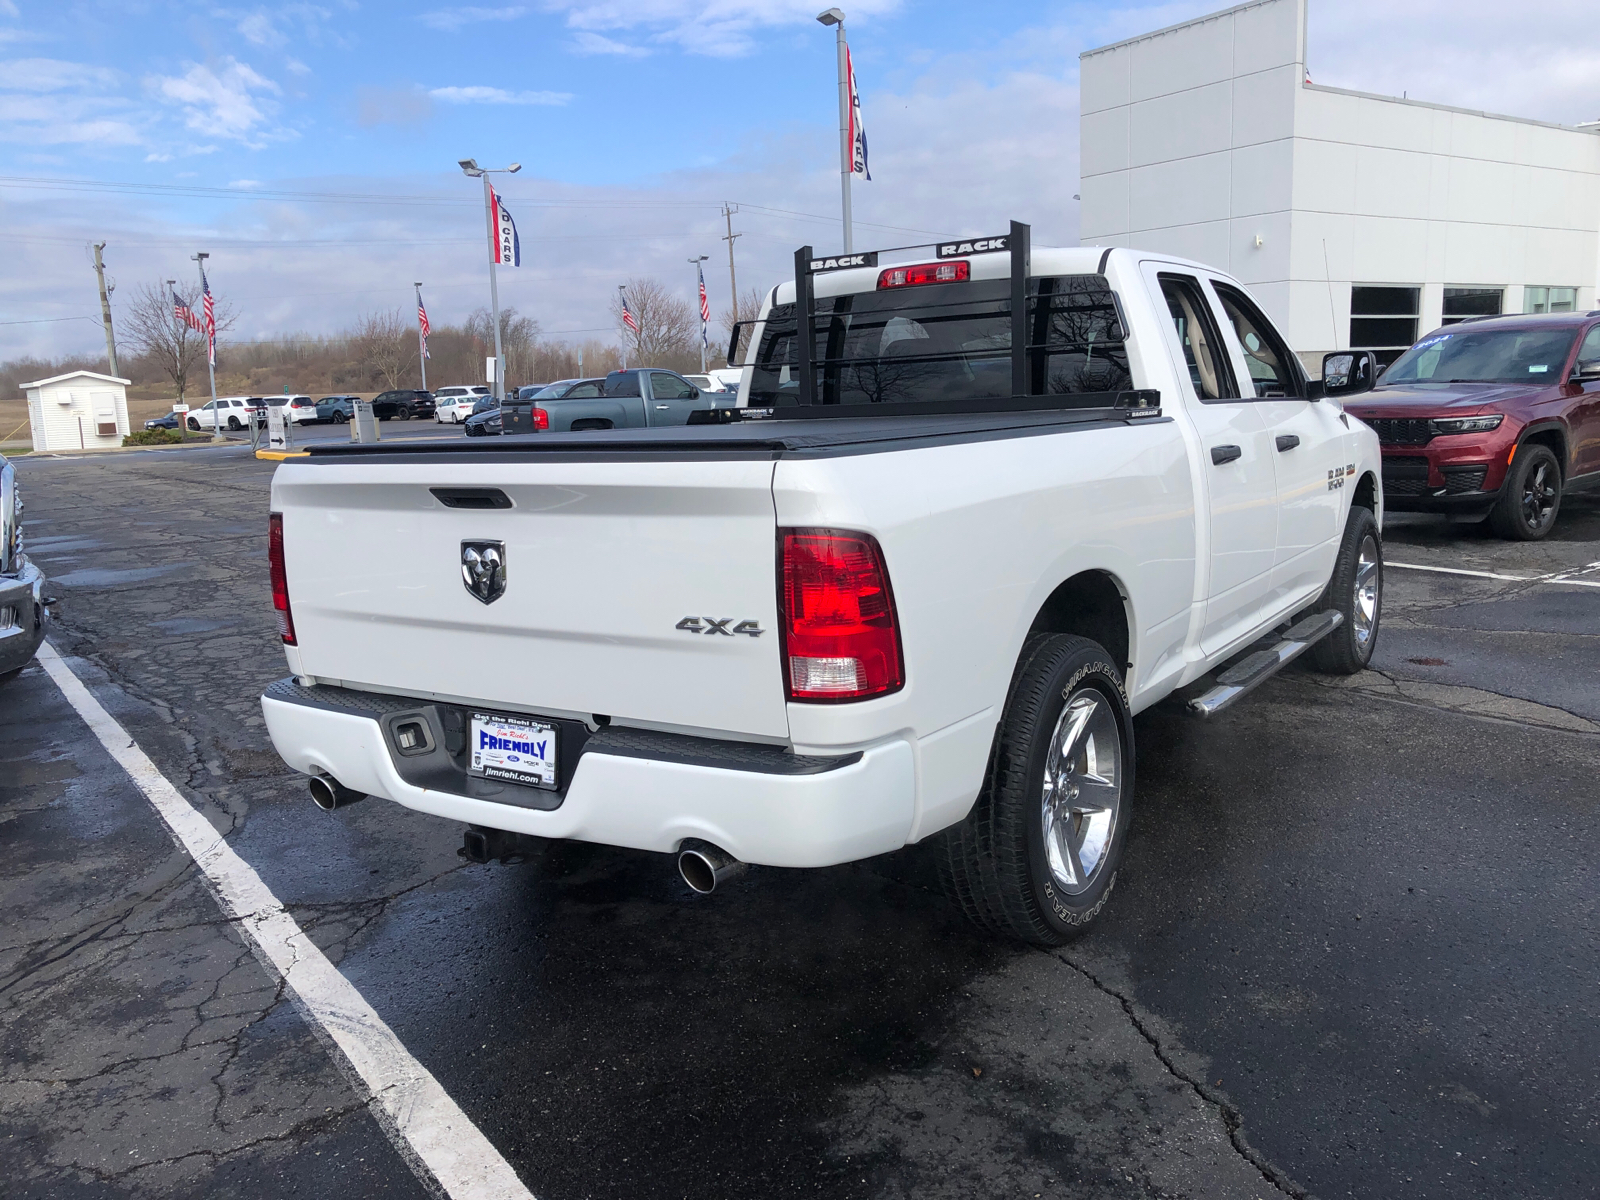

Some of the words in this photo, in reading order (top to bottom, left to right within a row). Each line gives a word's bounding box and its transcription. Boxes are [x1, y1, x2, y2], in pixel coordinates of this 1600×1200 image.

[502, 228, 511, 262] CARS
[810, 255, 865, 270] BACK
[941, 238, 1005, 256] RACK
[1131, 410, 1158, 418] BACKRACK
[675, 616, 766, 638] 4X4
[474, 713, 490, 721] Get
[508, 718, 530, 727] Riehl
[531, 721, 551, 730] Deal
[496, 729, 508, 737] Jim
[480, 729, 547, 760] FRIENDLY
[485, 767, 539, 784] jimriehl.com
